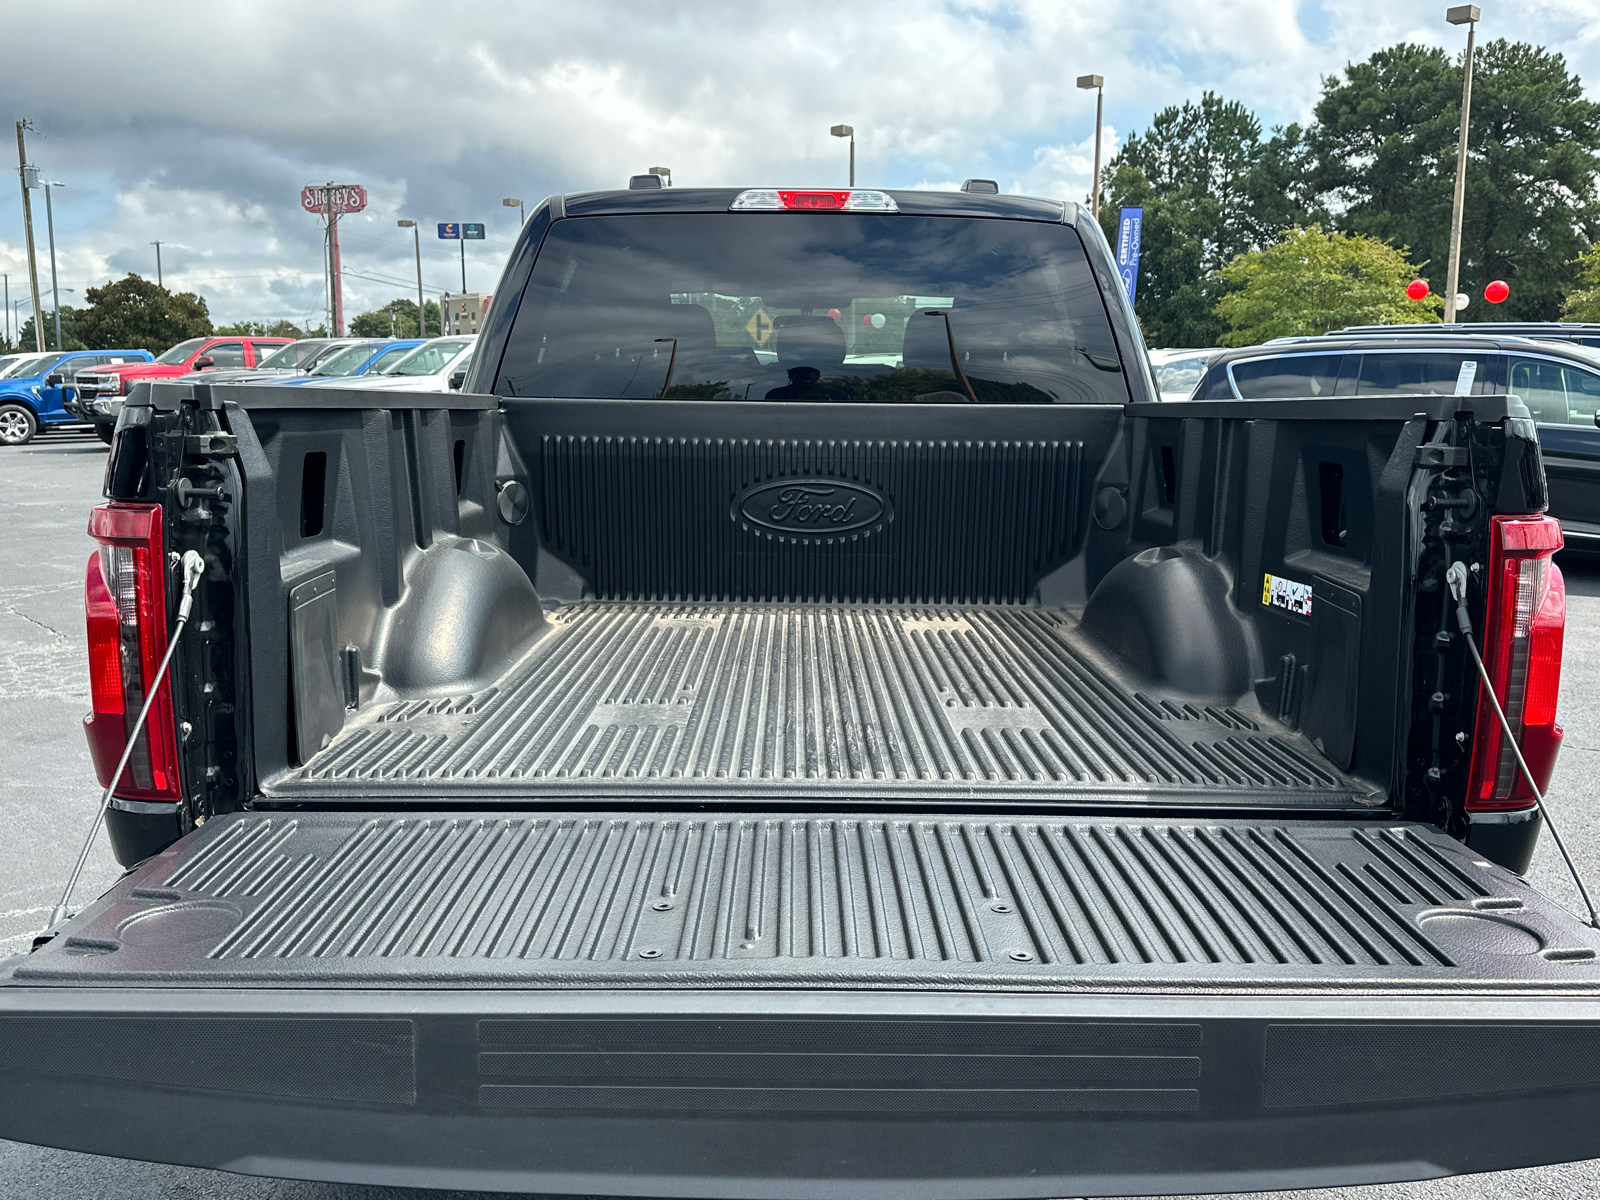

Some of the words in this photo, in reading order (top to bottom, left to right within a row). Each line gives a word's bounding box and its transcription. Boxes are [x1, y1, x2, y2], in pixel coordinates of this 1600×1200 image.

[1120, 217, 1131, 266] CERTIFIED
[1128, 217, 1140, 266] Pre-Owned
[769, 486, 857, 524] Ford
